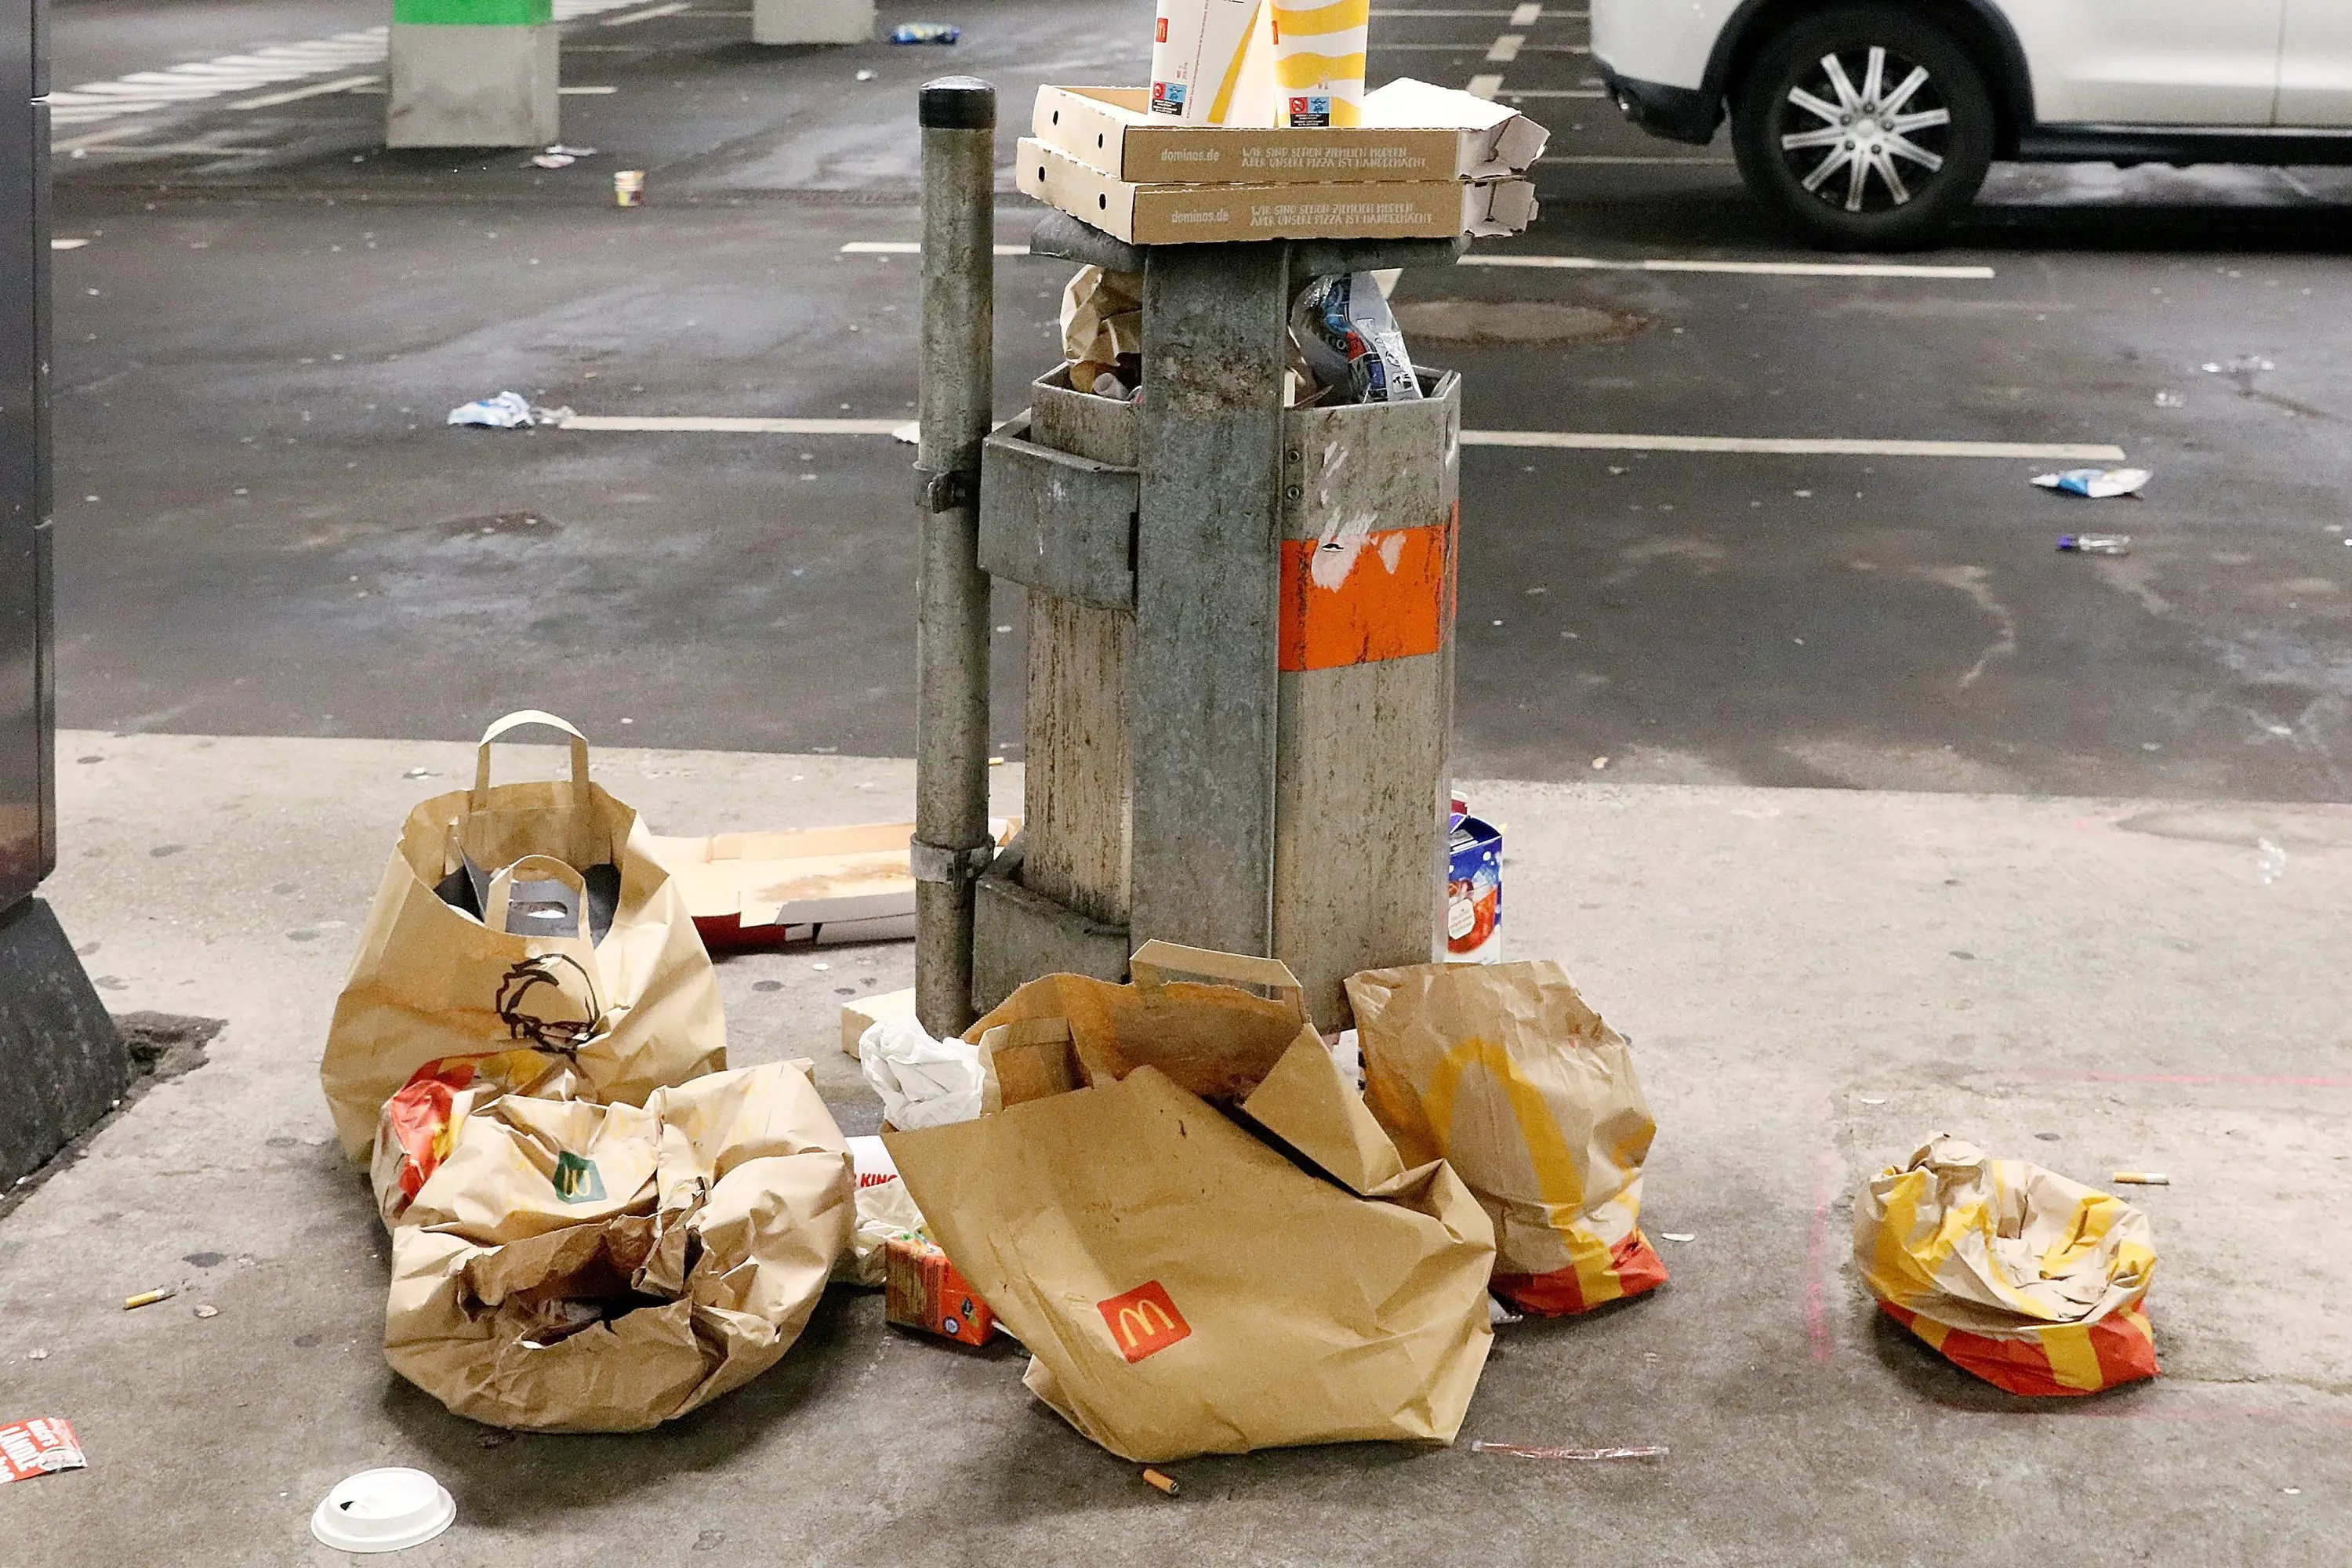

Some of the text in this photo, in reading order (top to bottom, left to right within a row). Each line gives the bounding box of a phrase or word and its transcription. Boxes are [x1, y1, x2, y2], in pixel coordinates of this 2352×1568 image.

[1160, 147, 1220, 162] dominos.de
[1242, 146, 1262, 157] WIR
[1265, 147, 1288, 158] SIND
[1241, 157, 1266, 168] ABER
[1269, 157, 1304, 168] UNSERE
[1307, 157, 1335, 168] PIZZA
[1338, 157, 1352, 168] IST
[1171, 208, 1229, 223] dominos.de
[1251, 205, 1272, 216] WIR
[1274, 205, 1297, 216] SIND
[1250, 216, 1275, 227] ABER
[1278, 215, 1312, 226] UNSERE
[1315, 214, 1343, 226] PIZZA
[1345, 214, 1359, 225] IST
[1119, 1299, 1175, 1348] M
